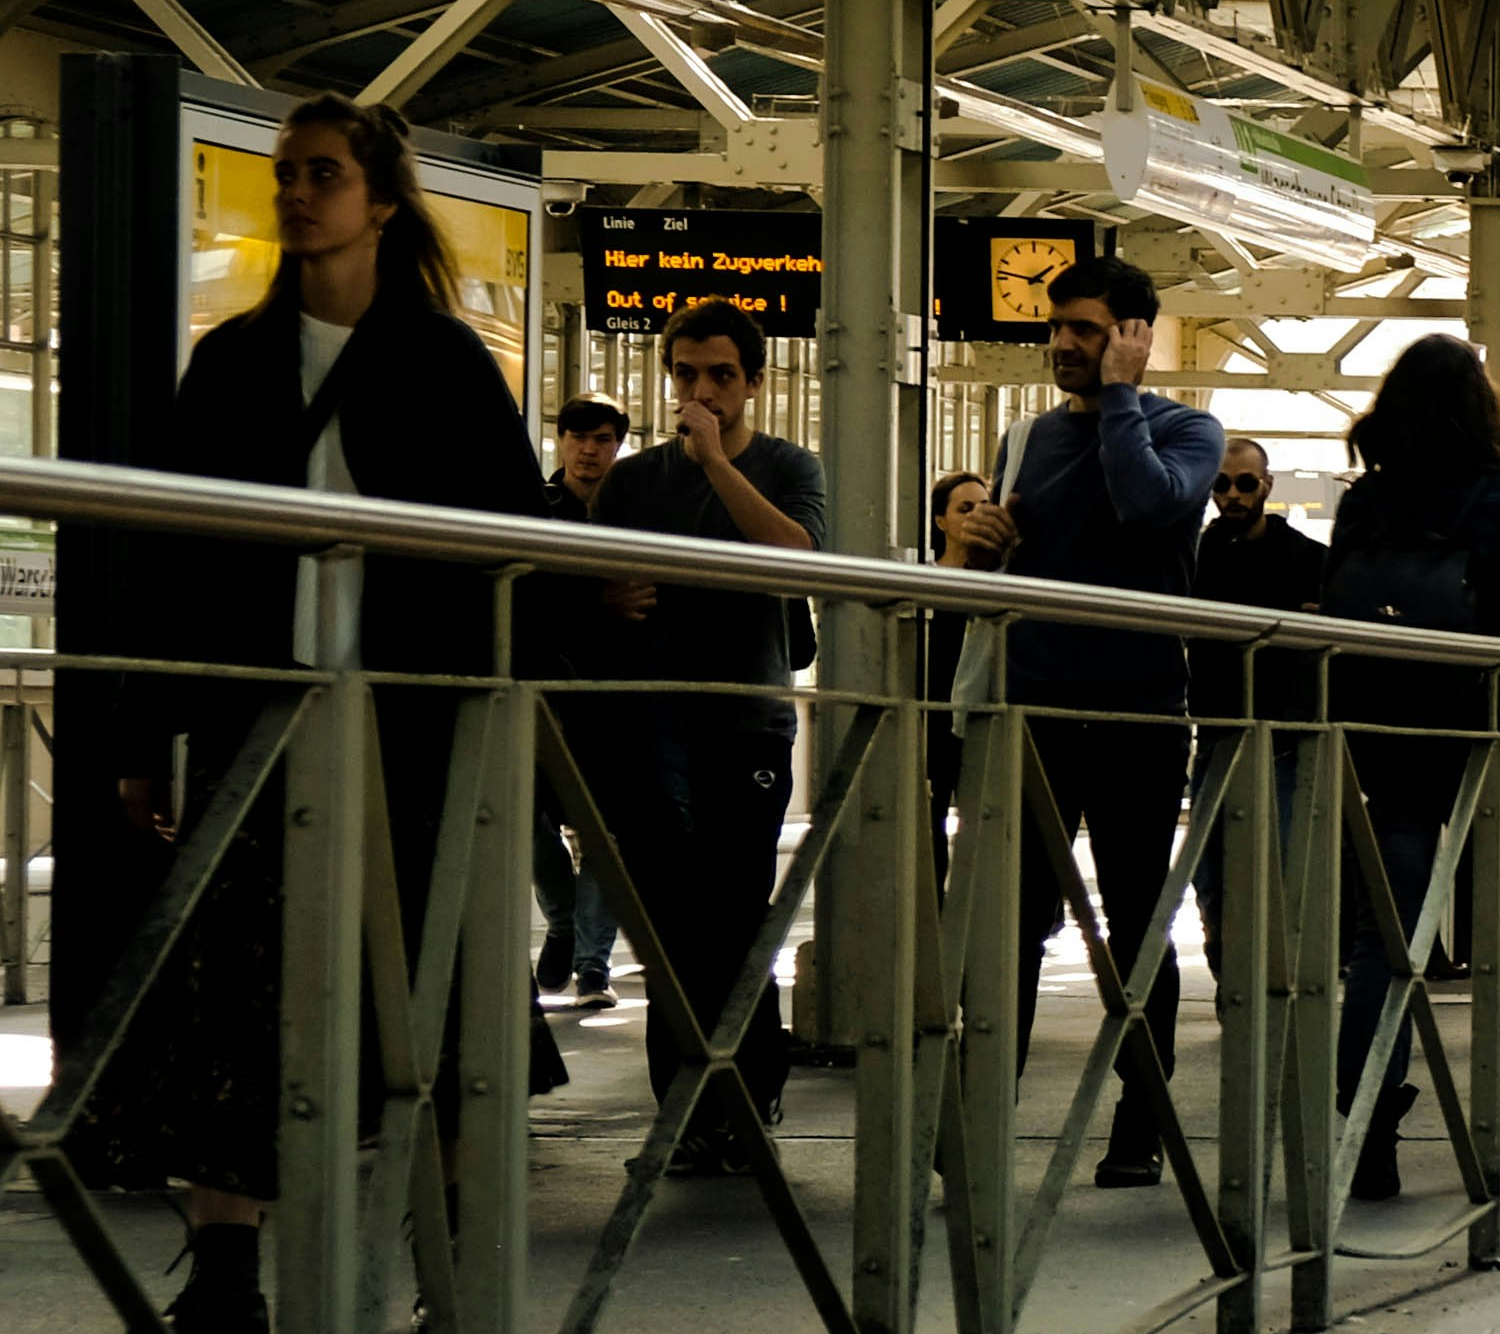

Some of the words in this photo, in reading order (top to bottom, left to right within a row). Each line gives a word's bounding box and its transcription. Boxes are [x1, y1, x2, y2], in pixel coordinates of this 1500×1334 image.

[603, 216, 635, 230] Linie
[663, 217, 689, 231] Ziel
[605, 250, 650, 268] Hier
[658, 251, 704, 270] kein
[712, 252, 823, 275] Zugverkeh
[606, 290, 643, 309] Out
[652, 292, 677, 313] of
[780, 294, 787, 313] !
[606, 317, 639, 331] Gleis
[643, 318, 651, 331] 2
